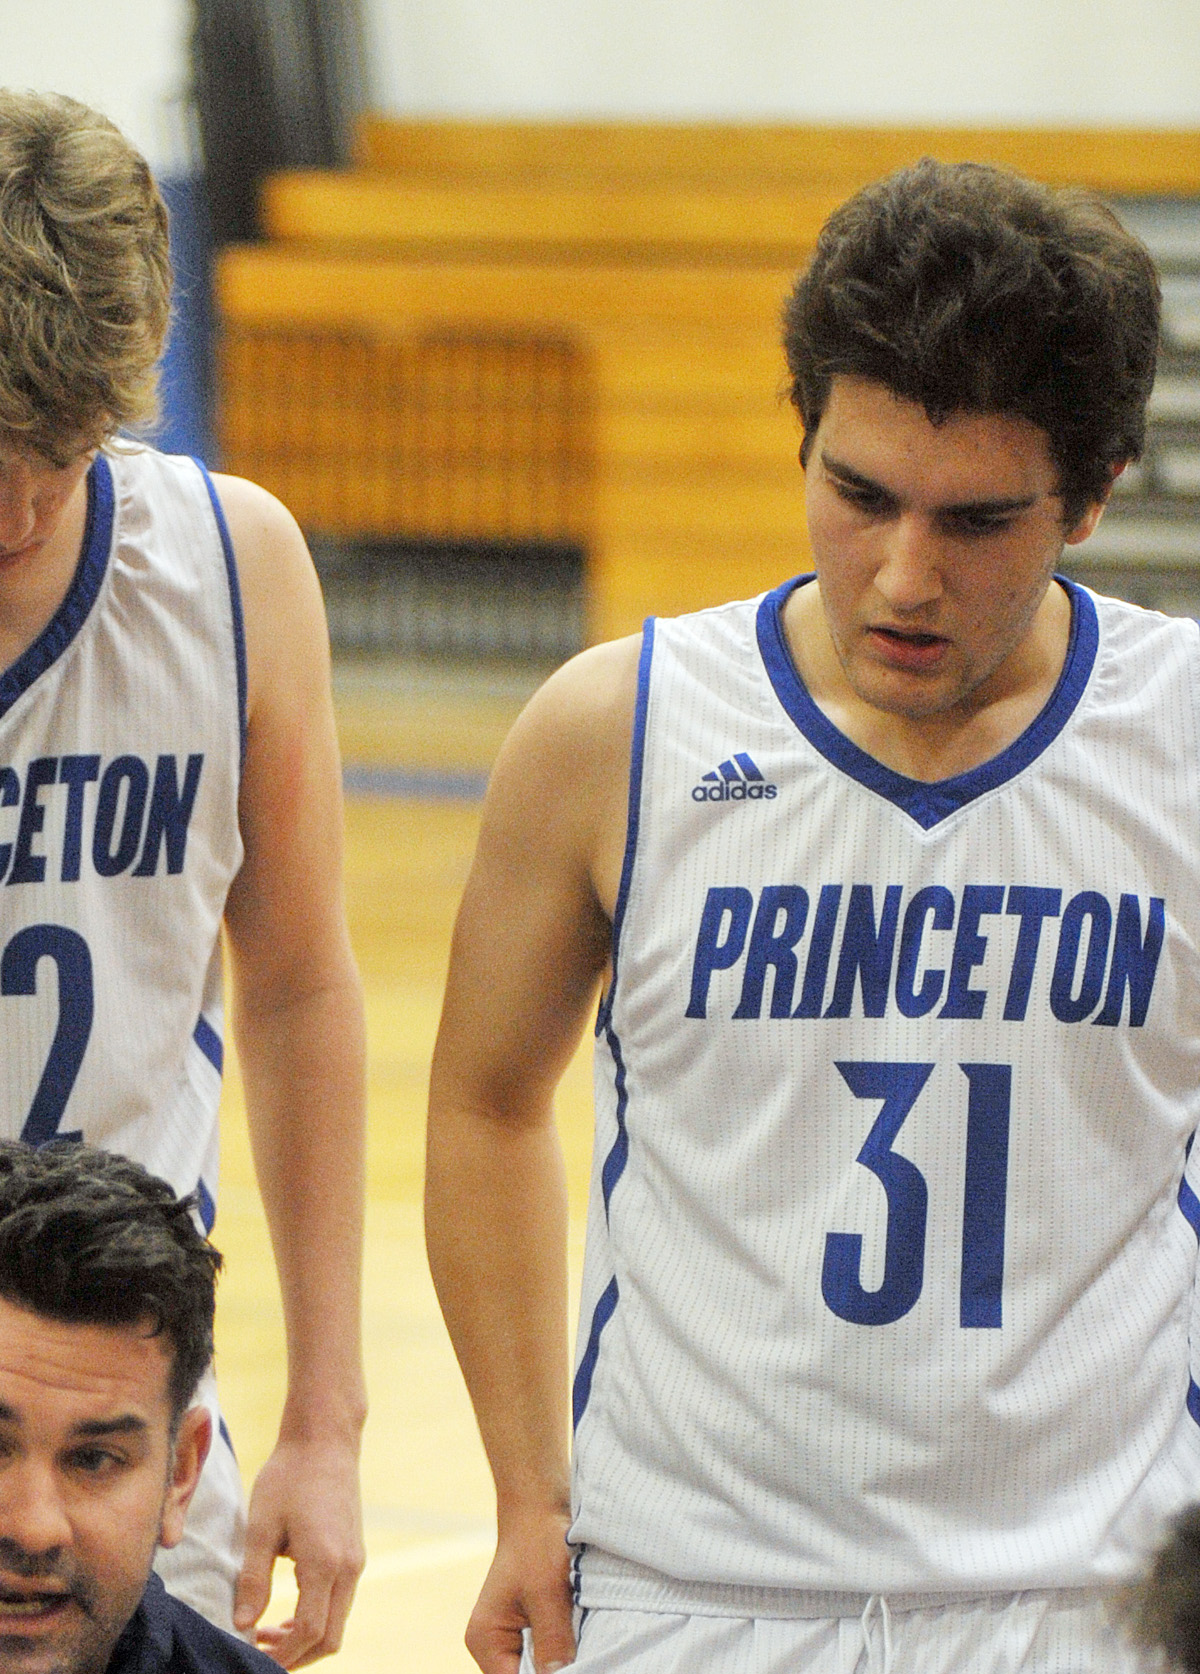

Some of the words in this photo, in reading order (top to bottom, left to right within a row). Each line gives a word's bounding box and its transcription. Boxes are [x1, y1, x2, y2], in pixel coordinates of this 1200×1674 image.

[692, 781, 777, 801] adidas
[685, 885, 1165, 1027] PRINCETON
[820, 1062, 1012, 1328] 31
